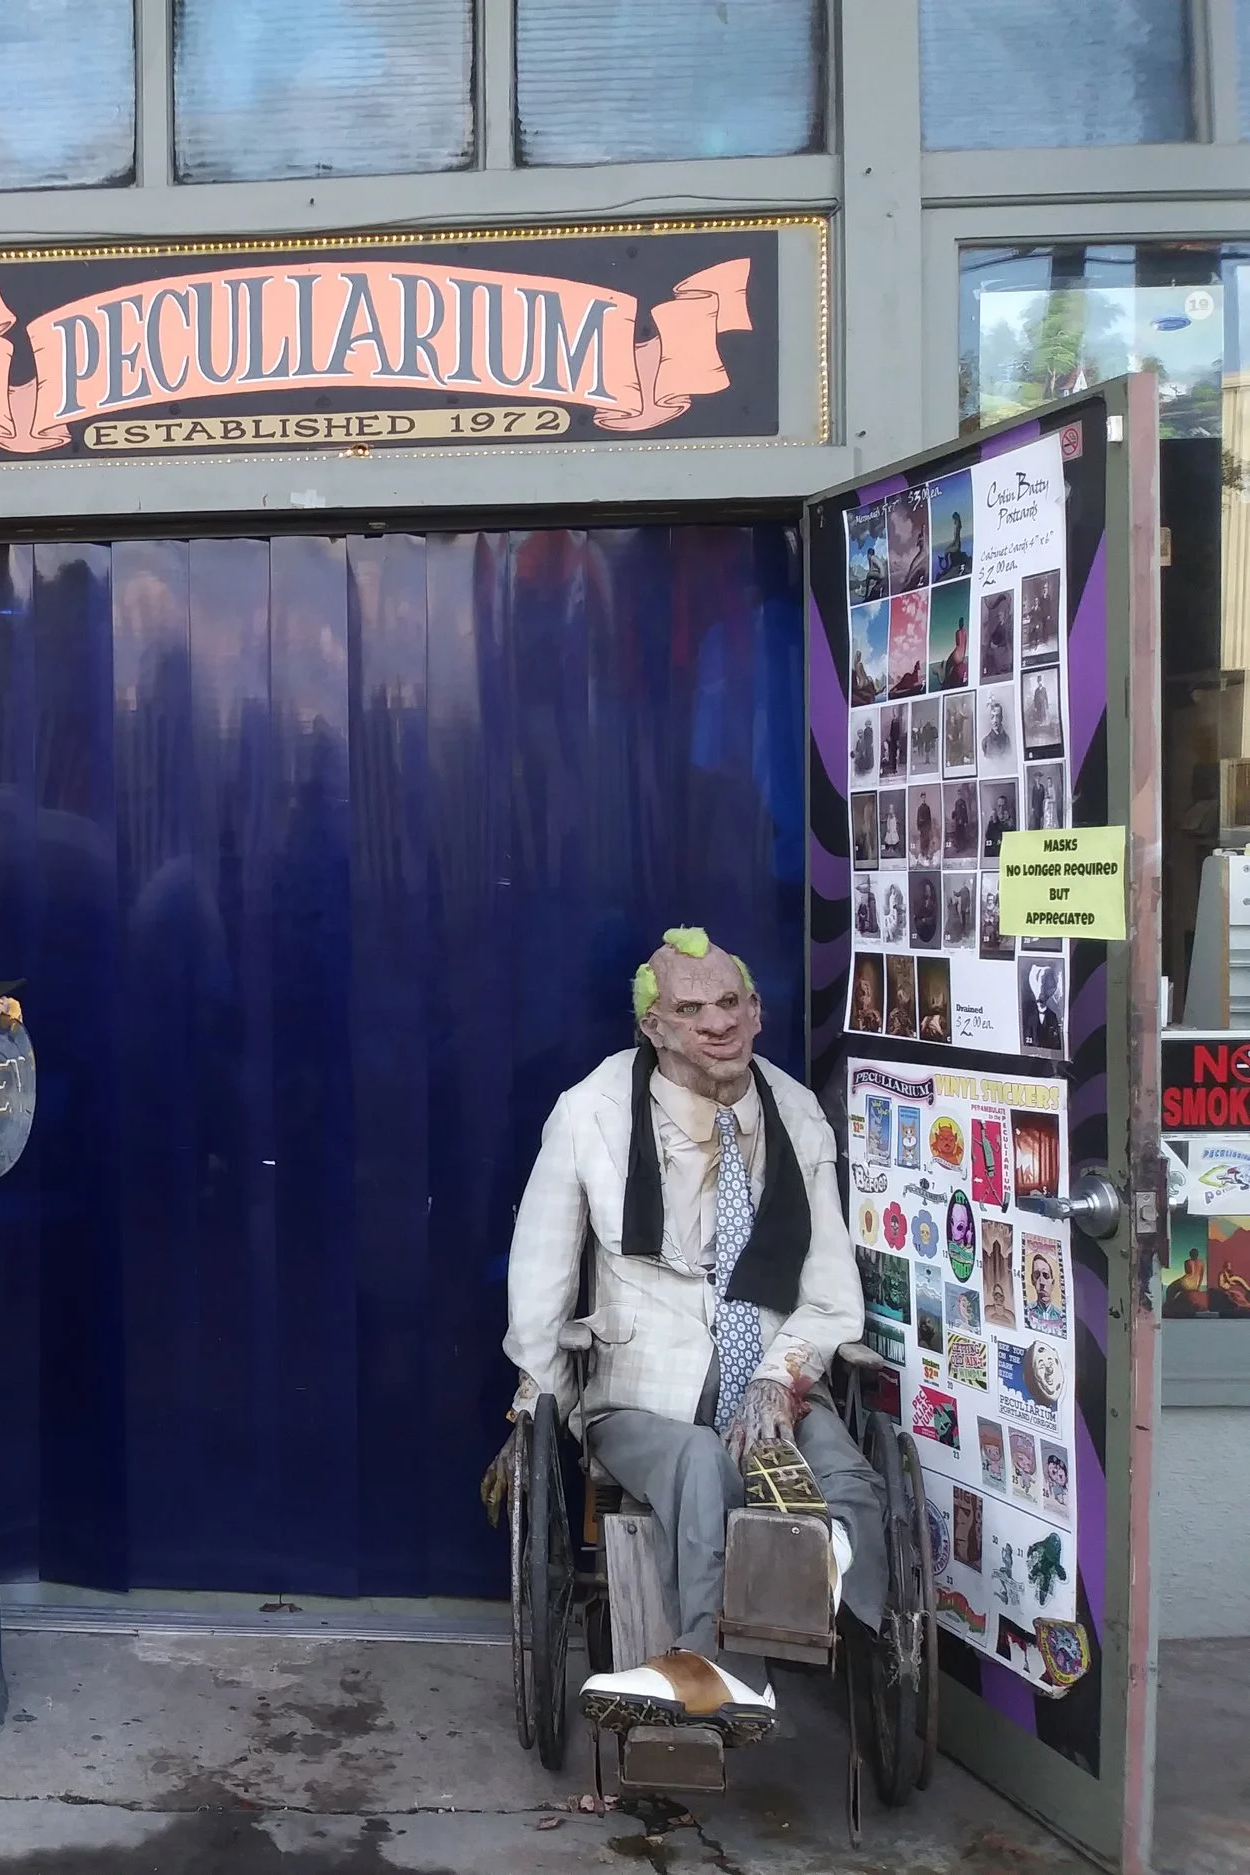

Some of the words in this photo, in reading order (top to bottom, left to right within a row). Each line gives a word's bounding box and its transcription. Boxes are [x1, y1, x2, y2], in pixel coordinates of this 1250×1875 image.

[50, 272, 618, 418] PECULIARIUM
[92, 415, 416, 447] ESTABLISHED
[450, 410, 561, 433] 1972
[986, 481, 1015, 508] Colin
[1016, 472, 1049, 501] Batty
[1043, 838, 1078, 853] MASKS
[1006, 864, 1021, 877] NO
[1022, 863, 1061, 877] LONGER
[1063, 862, 1118, 876] REQUIRED
[1049, 888, 1070, 901] BUT
[1025, 911, 1095, 926] APPRECIATED
[956, 1004, 983, 1014] Drained
[855, 1071, 930, 1097] PECULIARIUM
[935, 1074, 979, 1100] VINYL
[981, 1078, 1060, 1111] STICKERS
[1163, 1086, 1250, 1127] SMOK
[1000, 1394, 1056, 1422] PECULIARIUM
